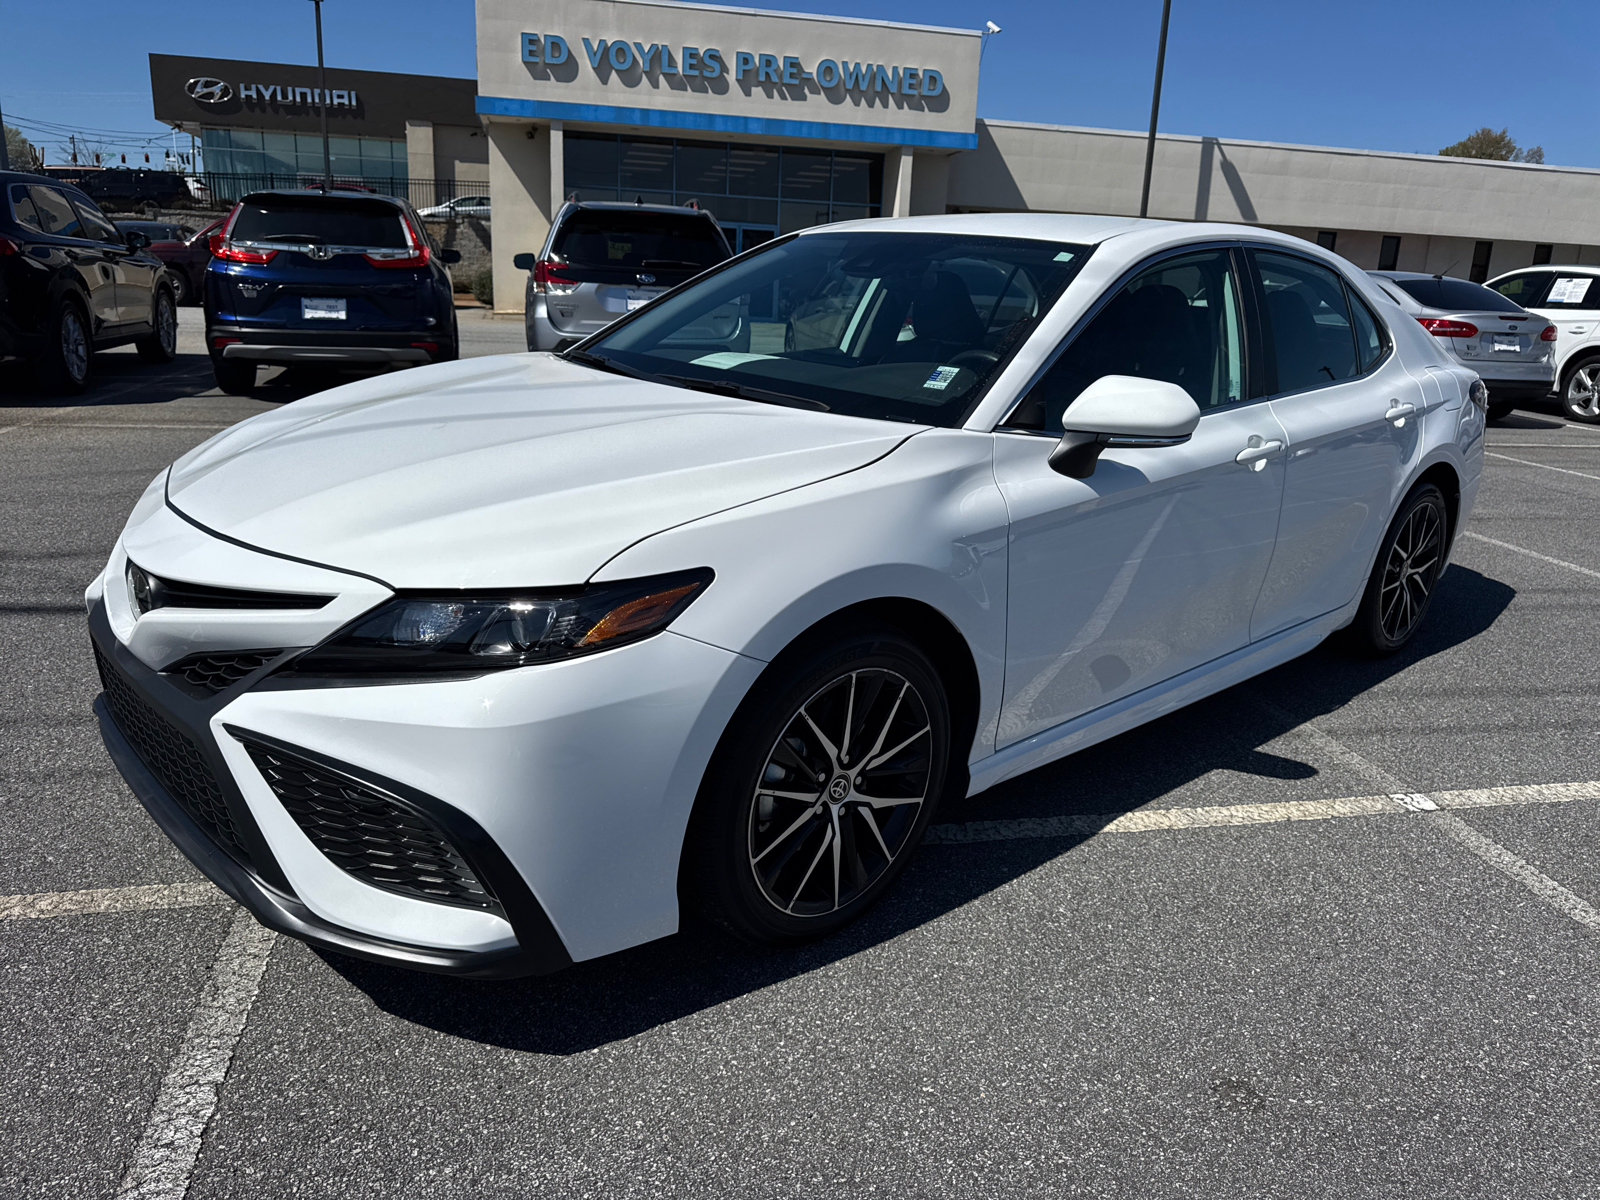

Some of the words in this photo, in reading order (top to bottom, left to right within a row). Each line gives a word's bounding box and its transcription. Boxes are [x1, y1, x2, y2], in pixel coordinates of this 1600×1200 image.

[521, 32, 569, 64] ED
[582, 37, 722, 78] VOYLES
[736, 51, 944, 97] PRE-OWNED
[239, 83, 357, 109] HYUNDAI
